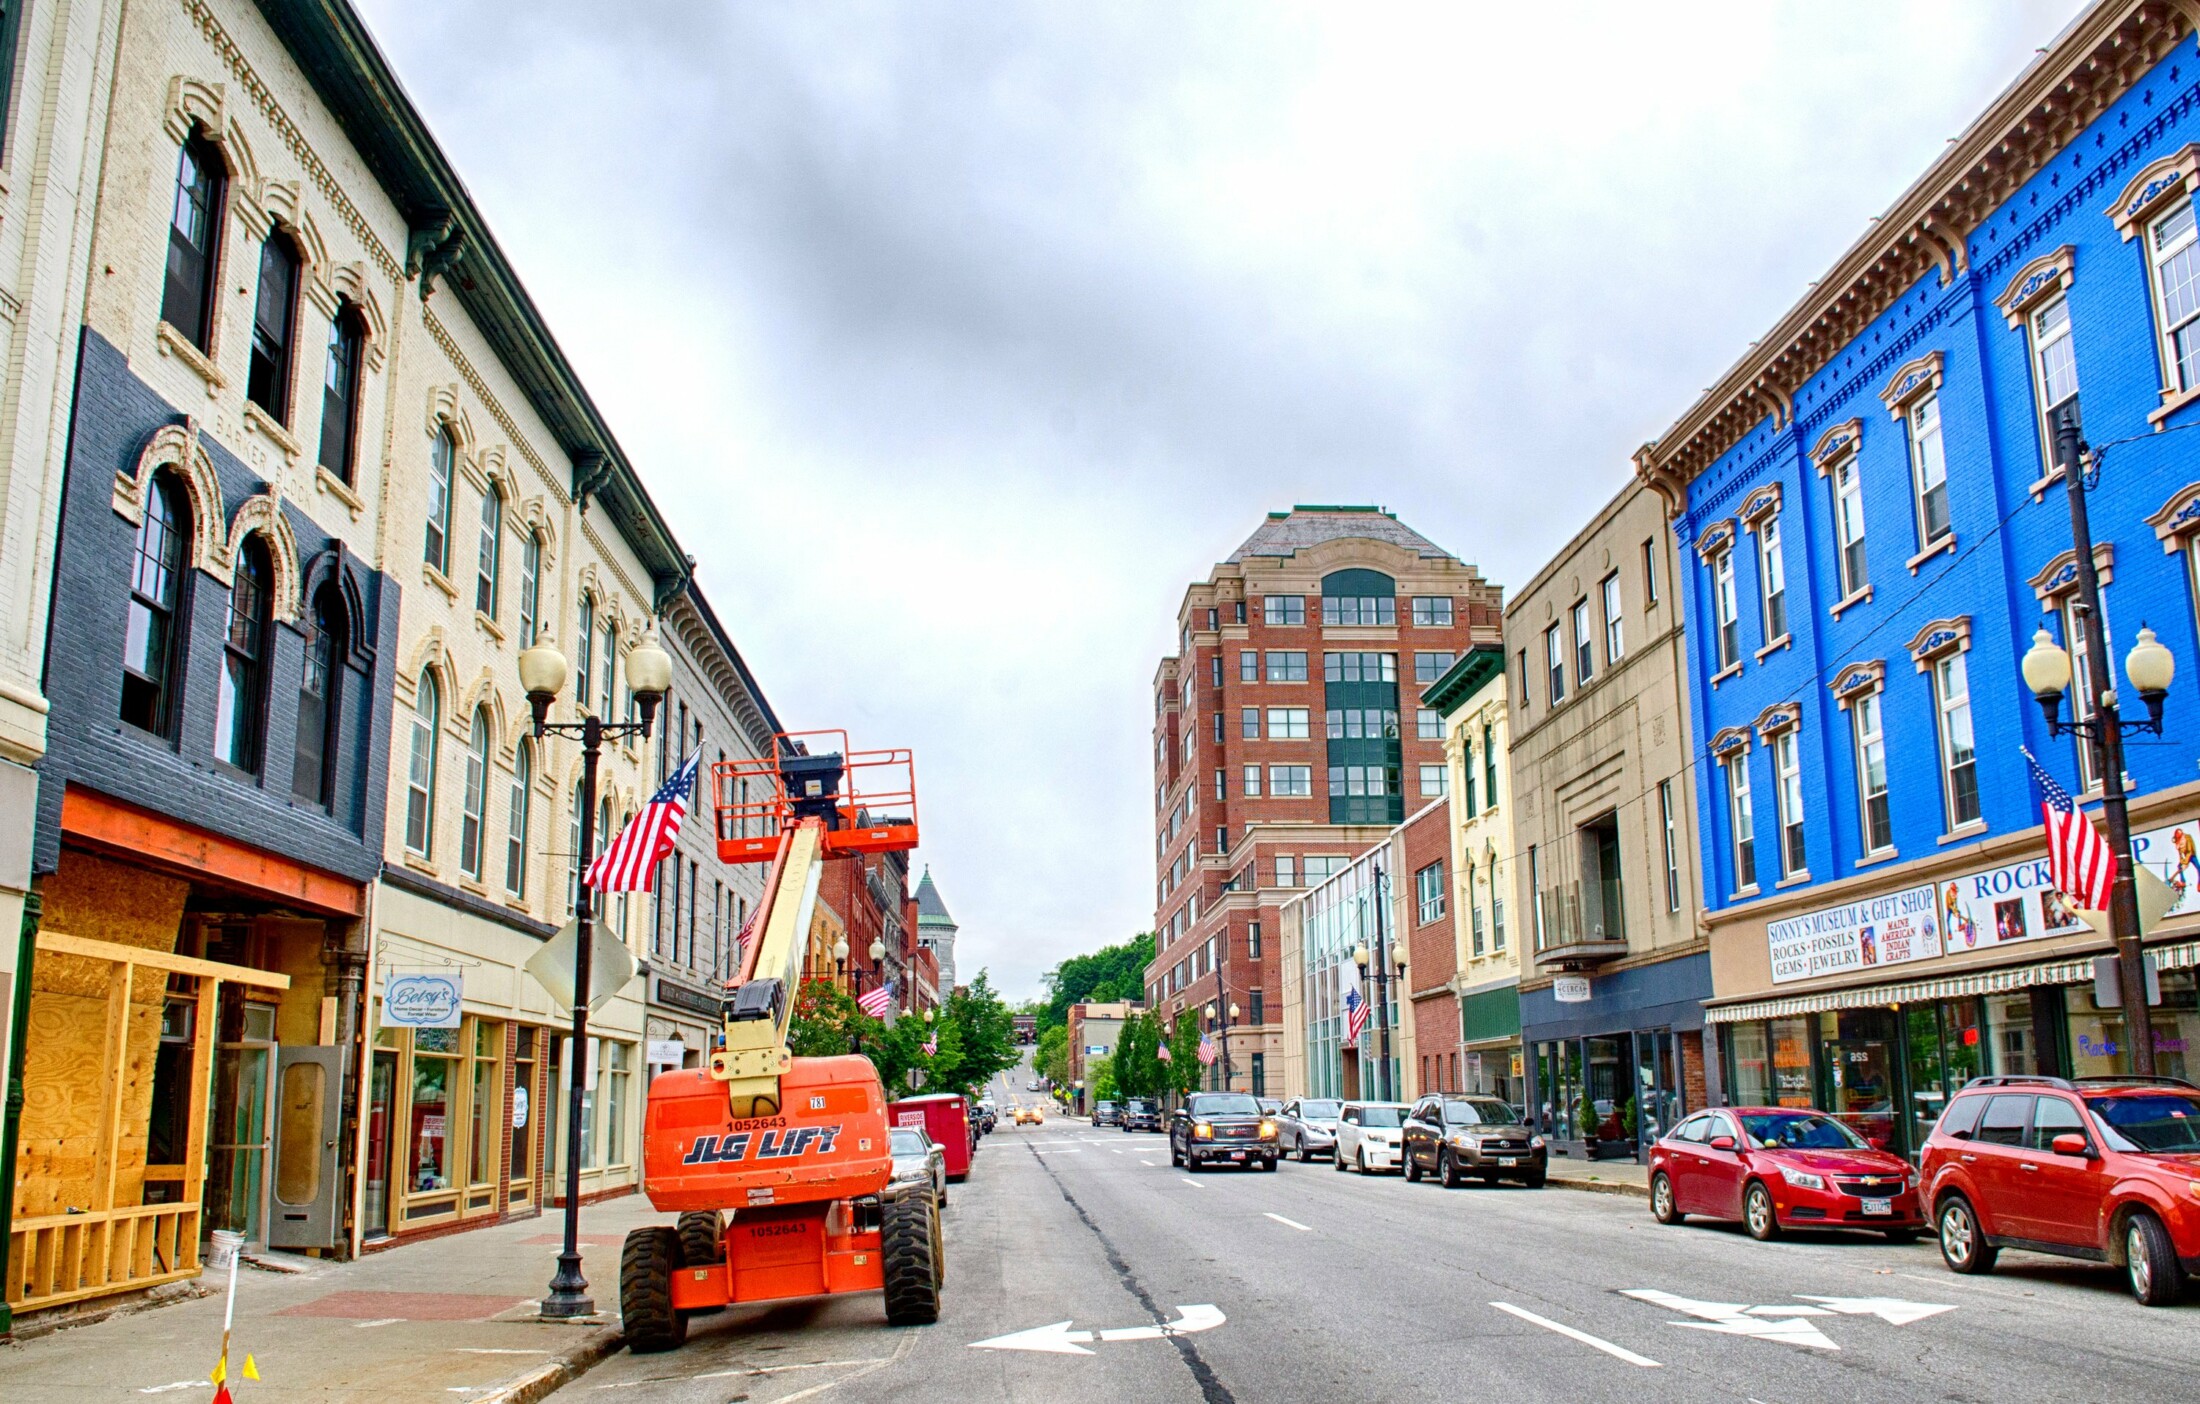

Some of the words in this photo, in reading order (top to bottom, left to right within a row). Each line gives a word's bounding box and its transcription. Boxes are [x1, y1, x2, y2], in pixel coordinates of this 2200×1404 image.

[216, 414, 267, 472] BARKER
[275, 465, 312, 511] BLOCK
[1972, 860, 2052, 899] ROCK
[1769, 917, 1811, 944] SONNY'S
[1812, 906, 1858, 935] MUSEUM
[1860, 904, 1869, 924] &
[1872, 896, 1899, 922] GIFT
[1901, 888, 1934, 916] SHOP
[1887, 917, 1910, 930] MAINE
[1881, 926, 1916, 943] AMERICAN
[1772, 942, 1806, 961] ROCKS
[1811, 931, 1855, 950] FOSSILS
[1886, 938, 1911, 952] INDIAN
[1775, 959, 1803, 976] GEMS
[1808, 948, 1859, 976] JEWELRY
[1885, 949, 1911, 962] CRAFTS
[394, 987, 450, 1006] Betsy's
[1561, 984, 1583, 993] CIRCA
[811, 1097, 825, 1109] 781
[726, 1116, 787, 1132] 1052643
[899, 1112, 923, 1122] RIVERSIDE
[683, 1132, 752, 1165] JLG
[756, 1124, 842, 1160] LIFT
[751, 1223, 807, 1238] 1052643
